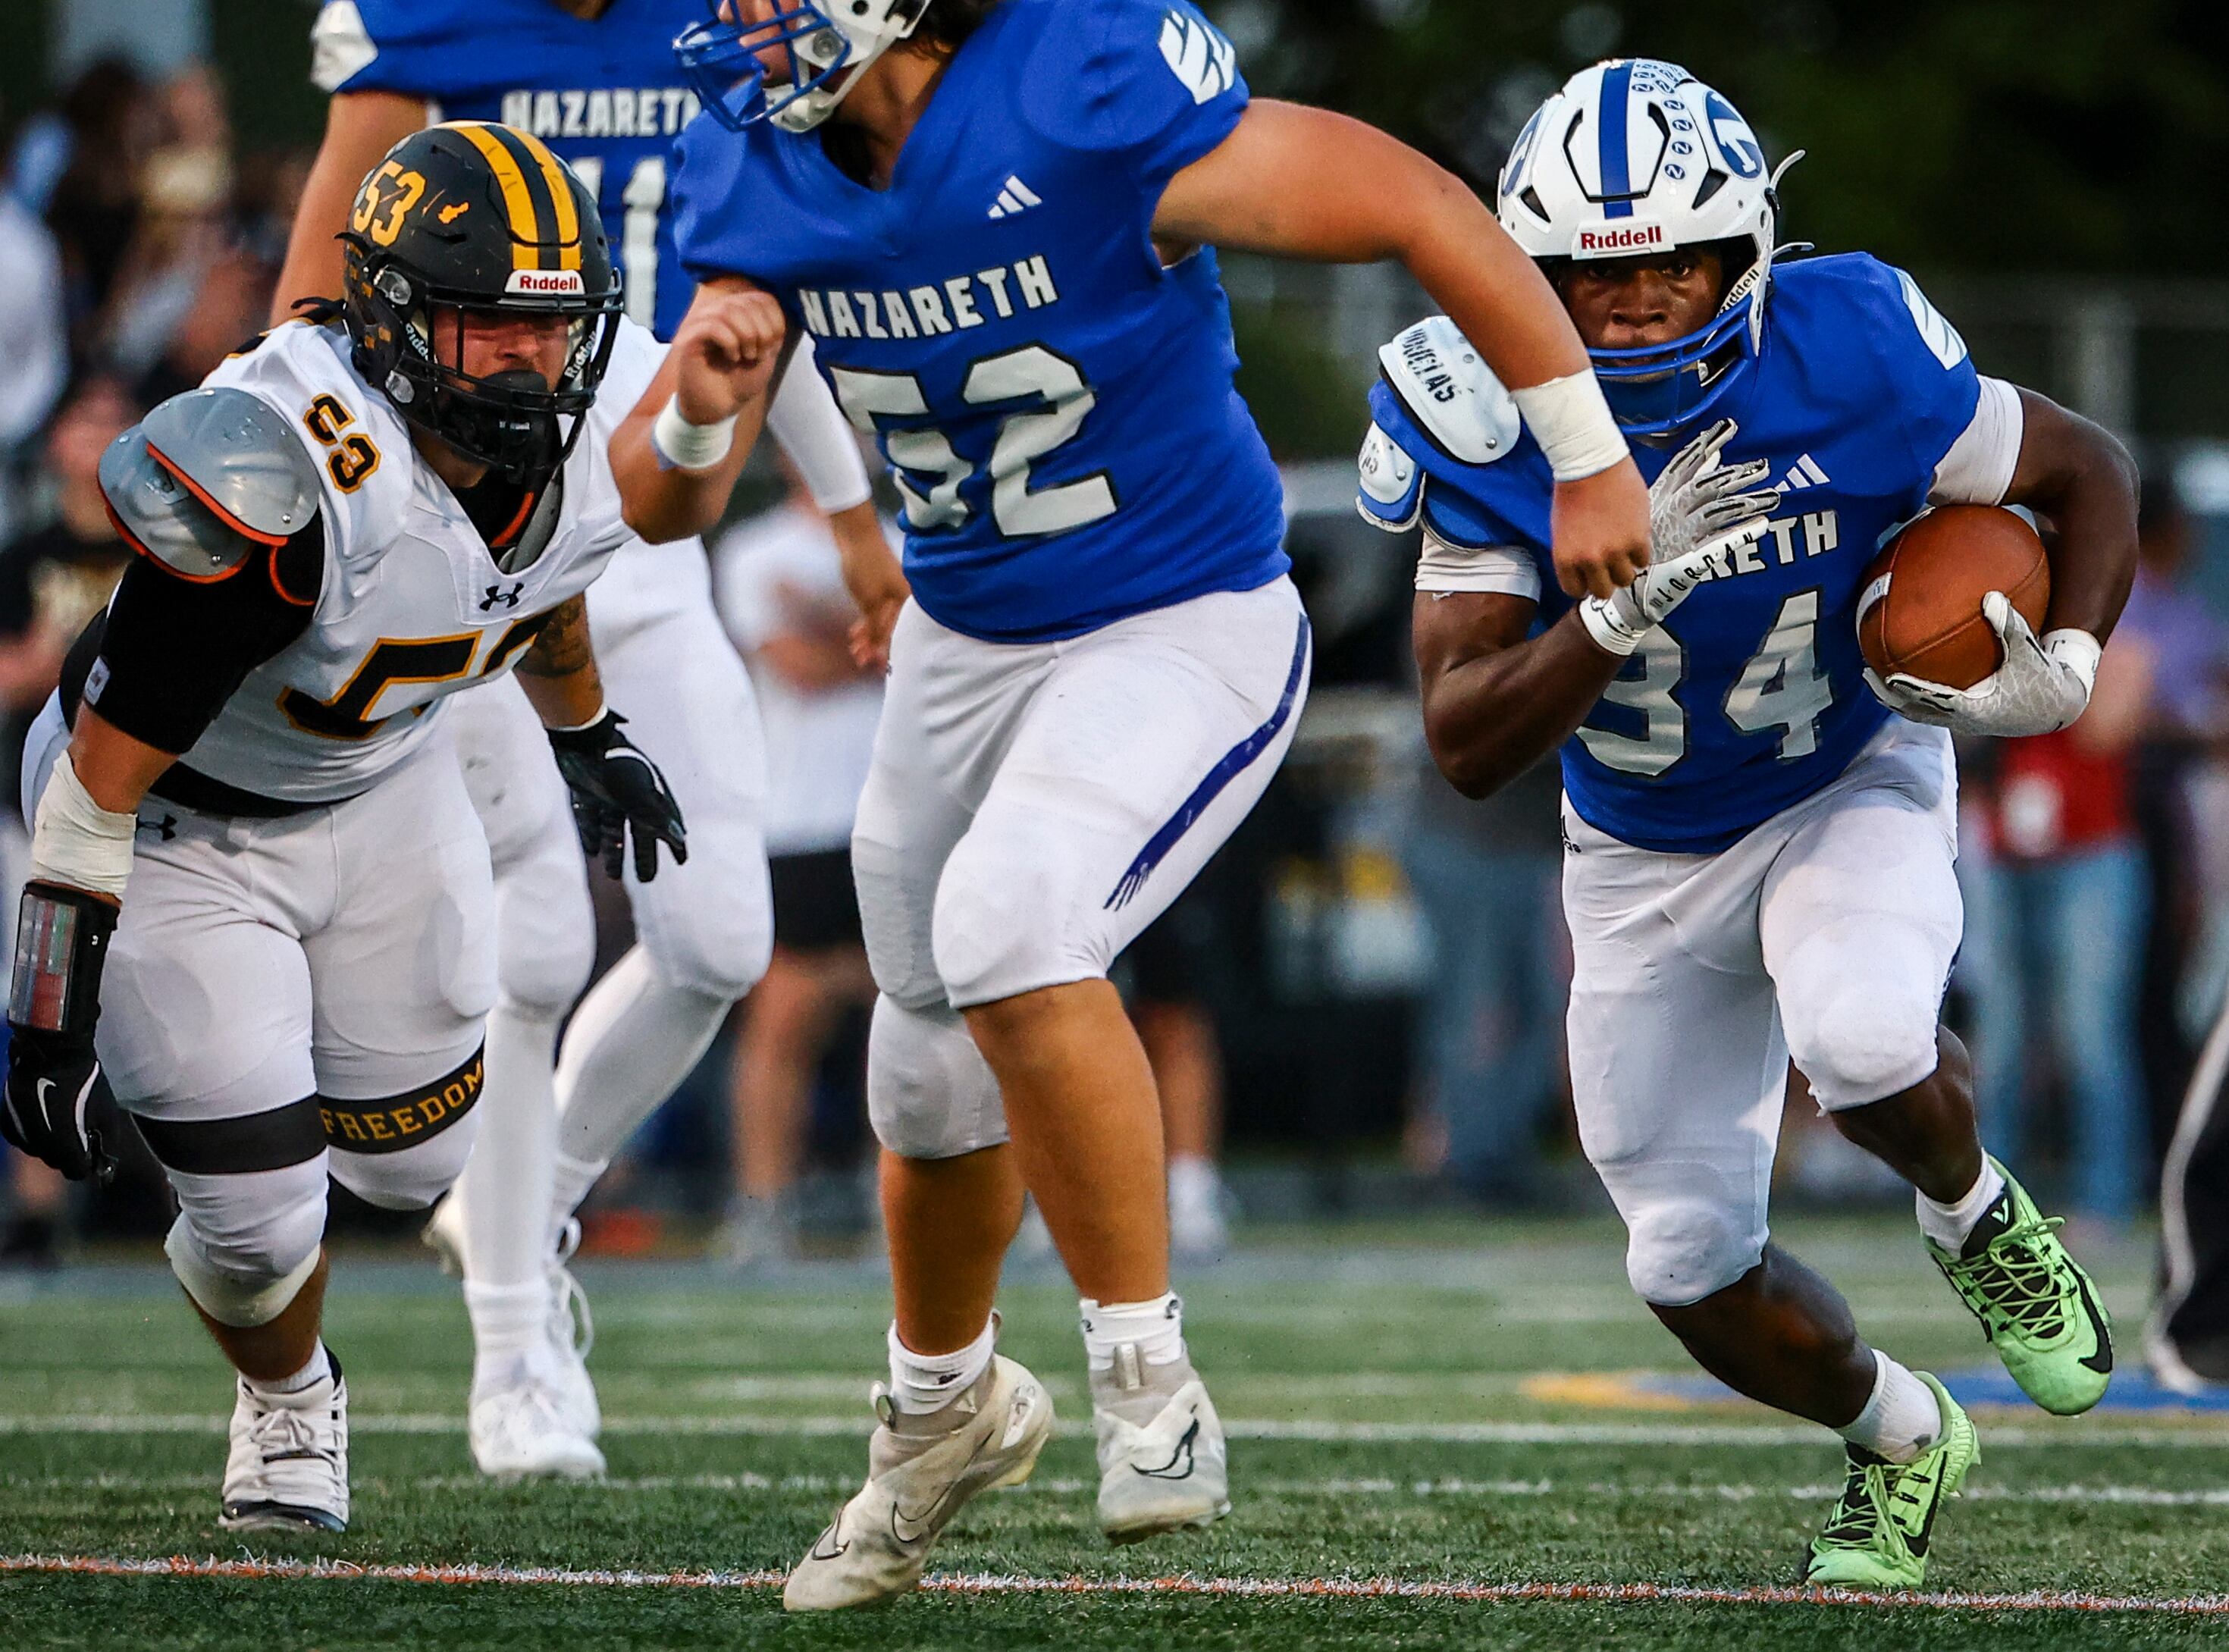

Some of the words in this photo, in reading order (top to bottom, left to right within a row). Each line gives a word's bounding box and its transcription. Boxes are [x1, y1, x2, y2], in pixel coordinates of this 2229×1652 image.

[353, 160, 426, 247] 53
[570, 155, 666, 331] 1
[1580, 226, 1662, 249] Riddell
[519, 275, 578, 290] Riddell
[798, 254, 1059, 340] NAZARETH
[405, 322, 429, 361] Ridd
[302, 393, 381, 494] 53
[830, 345, 1118, 537] 52
[1575, 591, 1833, 776] 34
[318, 1061, 484, 1141] FREEDOM
